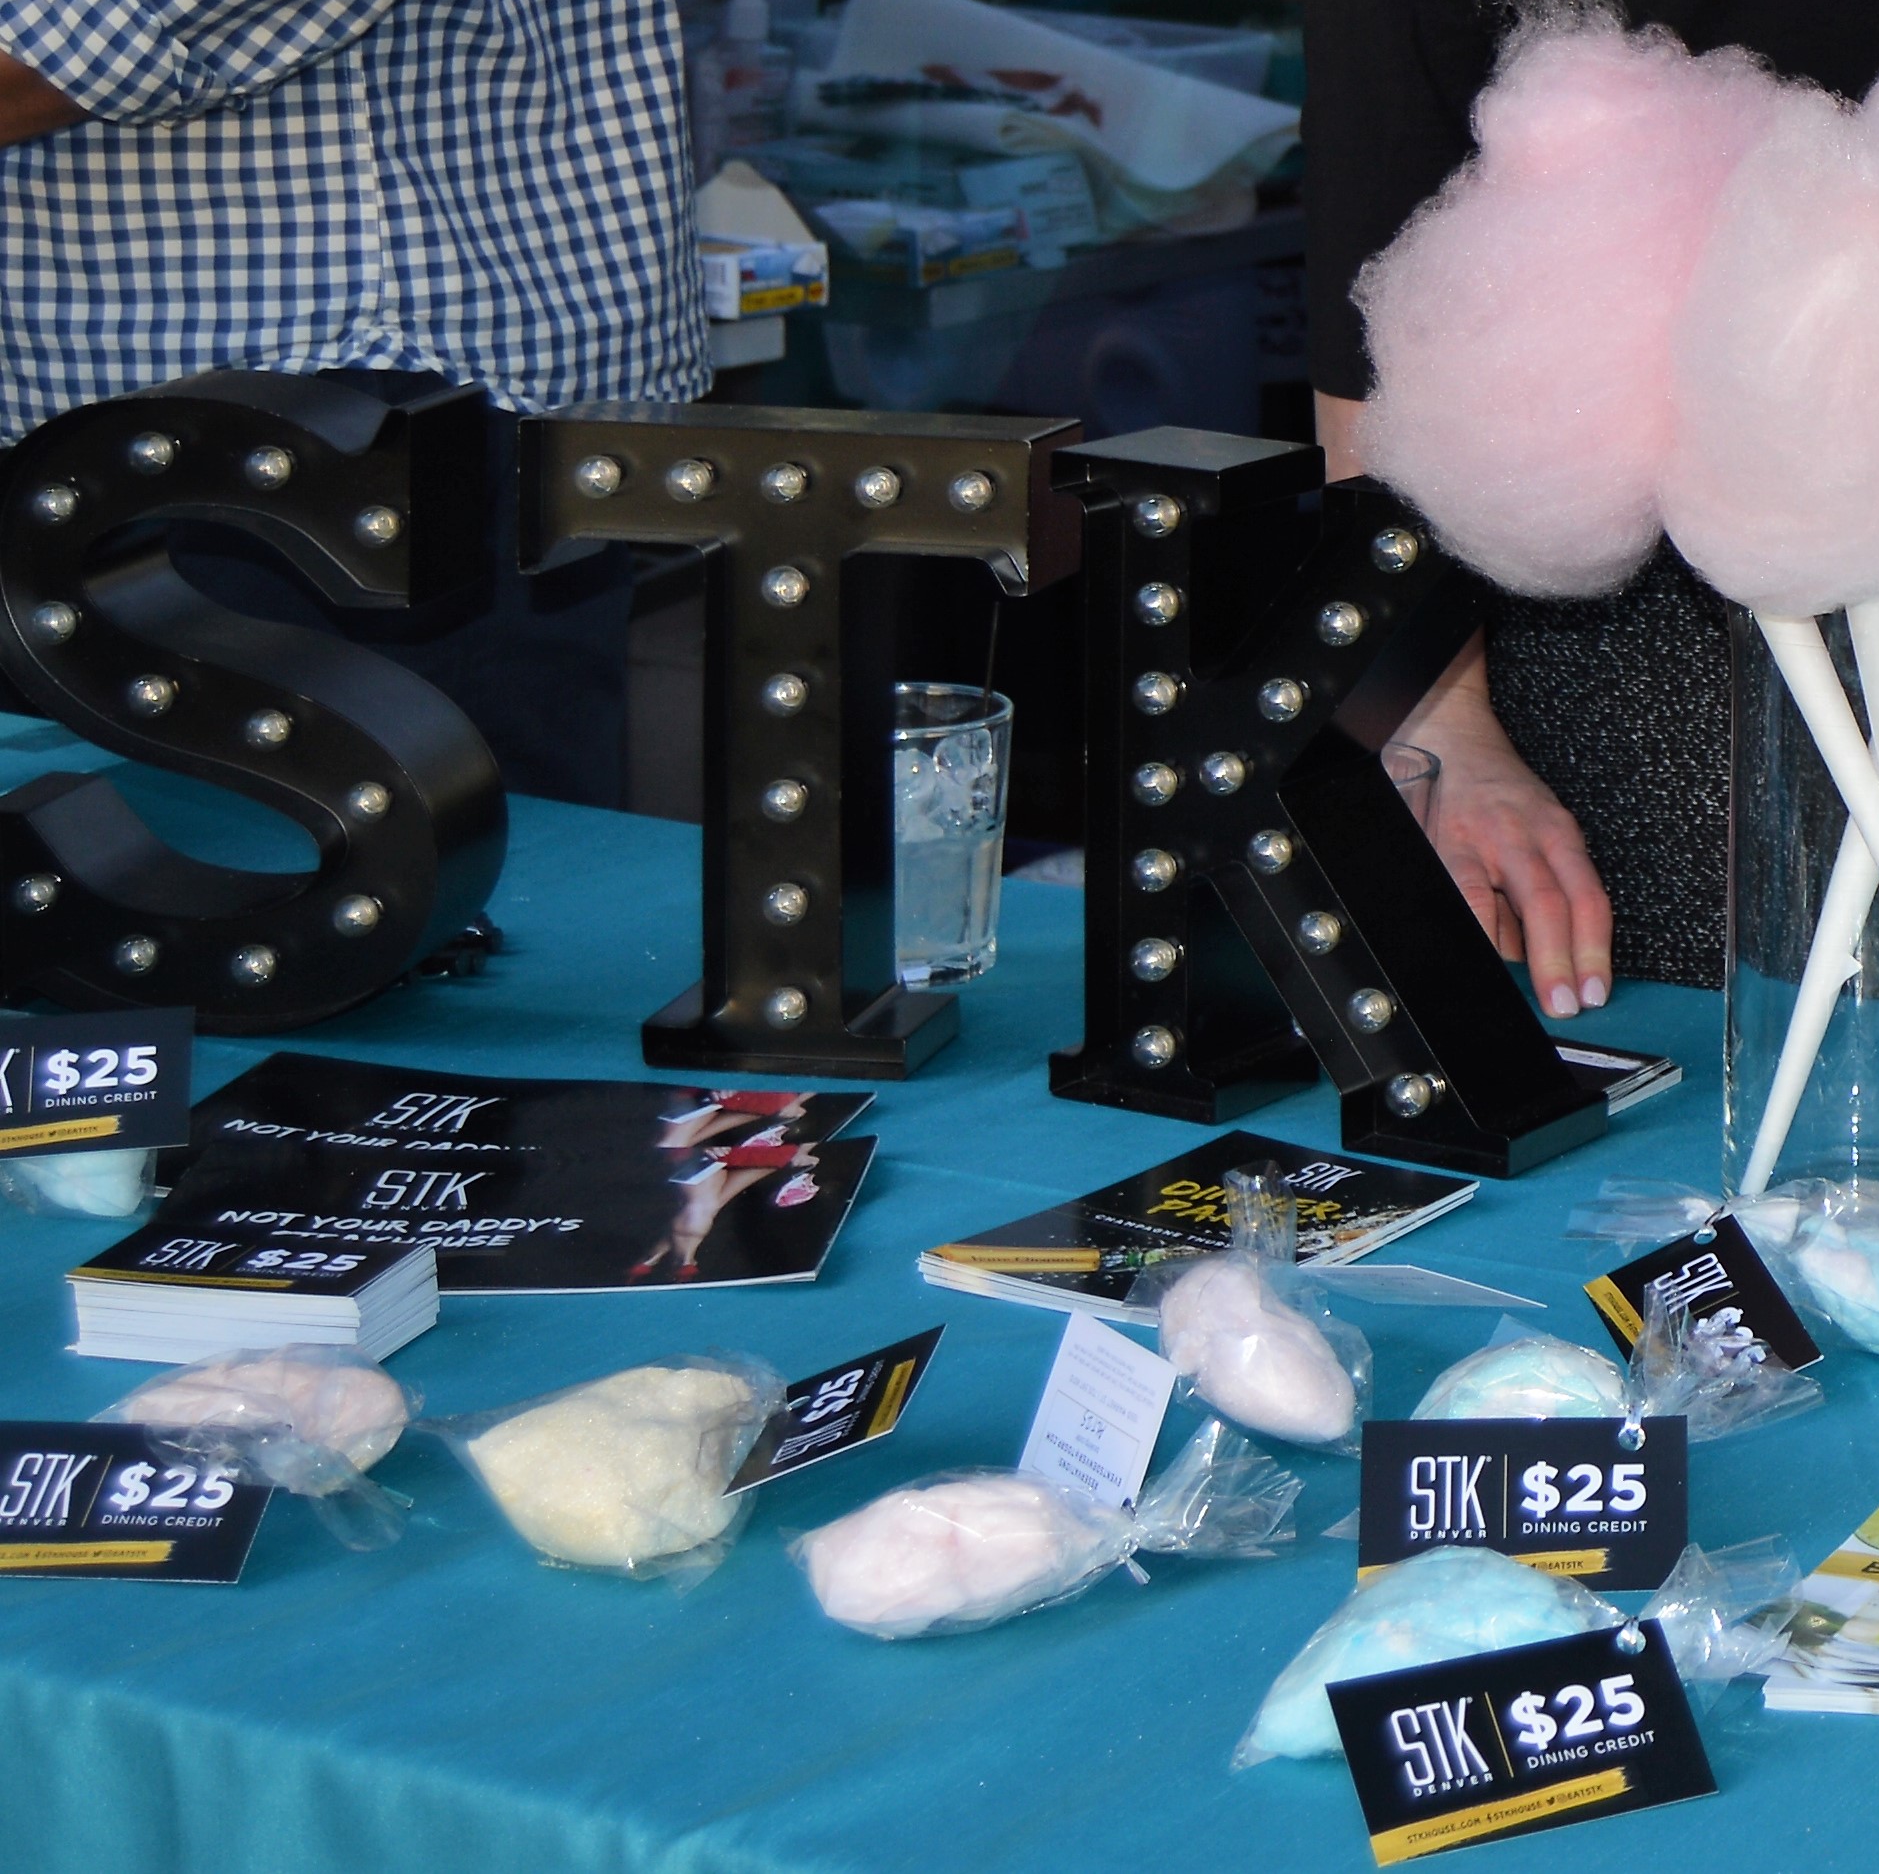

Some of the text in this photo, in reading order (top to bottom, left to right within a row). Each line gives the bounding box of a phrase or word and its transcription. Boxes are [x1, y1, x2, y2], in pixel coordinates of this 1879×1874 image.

[0, 371, 1607, 1176] STK
[45, 1046, 158, 1095] $25
[45, 1091, 158, 1108] DINING CREDIT
[372, 1092, 500, 1132] STK
[224, 1118, 305, 1138] NOT
[306, 1129, 400, 1149] YOUR
[366, 1169, 488, 1210] STK
[1285, 1161, 1362, 1191] STK
[218, 1210, 584, 1234] NOT YOUR DADDY'S
[1095, 1213, 1183, 1240] CHAMPAGNE
[145, 1238, 367, 1273] STK $25
[1653, 1252, 1734, 1315] STK
[801, 1368, 865, 1424] $25
[0, 1452, 240, 1518] STK $25
[1410, 1454, 1648, 1531] STK $25
[101, 1514, 158, 1526] DINING
[164, 1515, 224, 1528] CREDIT
[1410, 1520, 1648, 1540] DENVER DINING CREDIT
[1509, 1673, 1647, 1750] $25
[1390, 1696, 1490, 1788] STK
[1413, 1730, 1656, 1797] DENVER DINING CREDIT
[1406, 1816, 1481, 1845] STKHOUSE.COM
